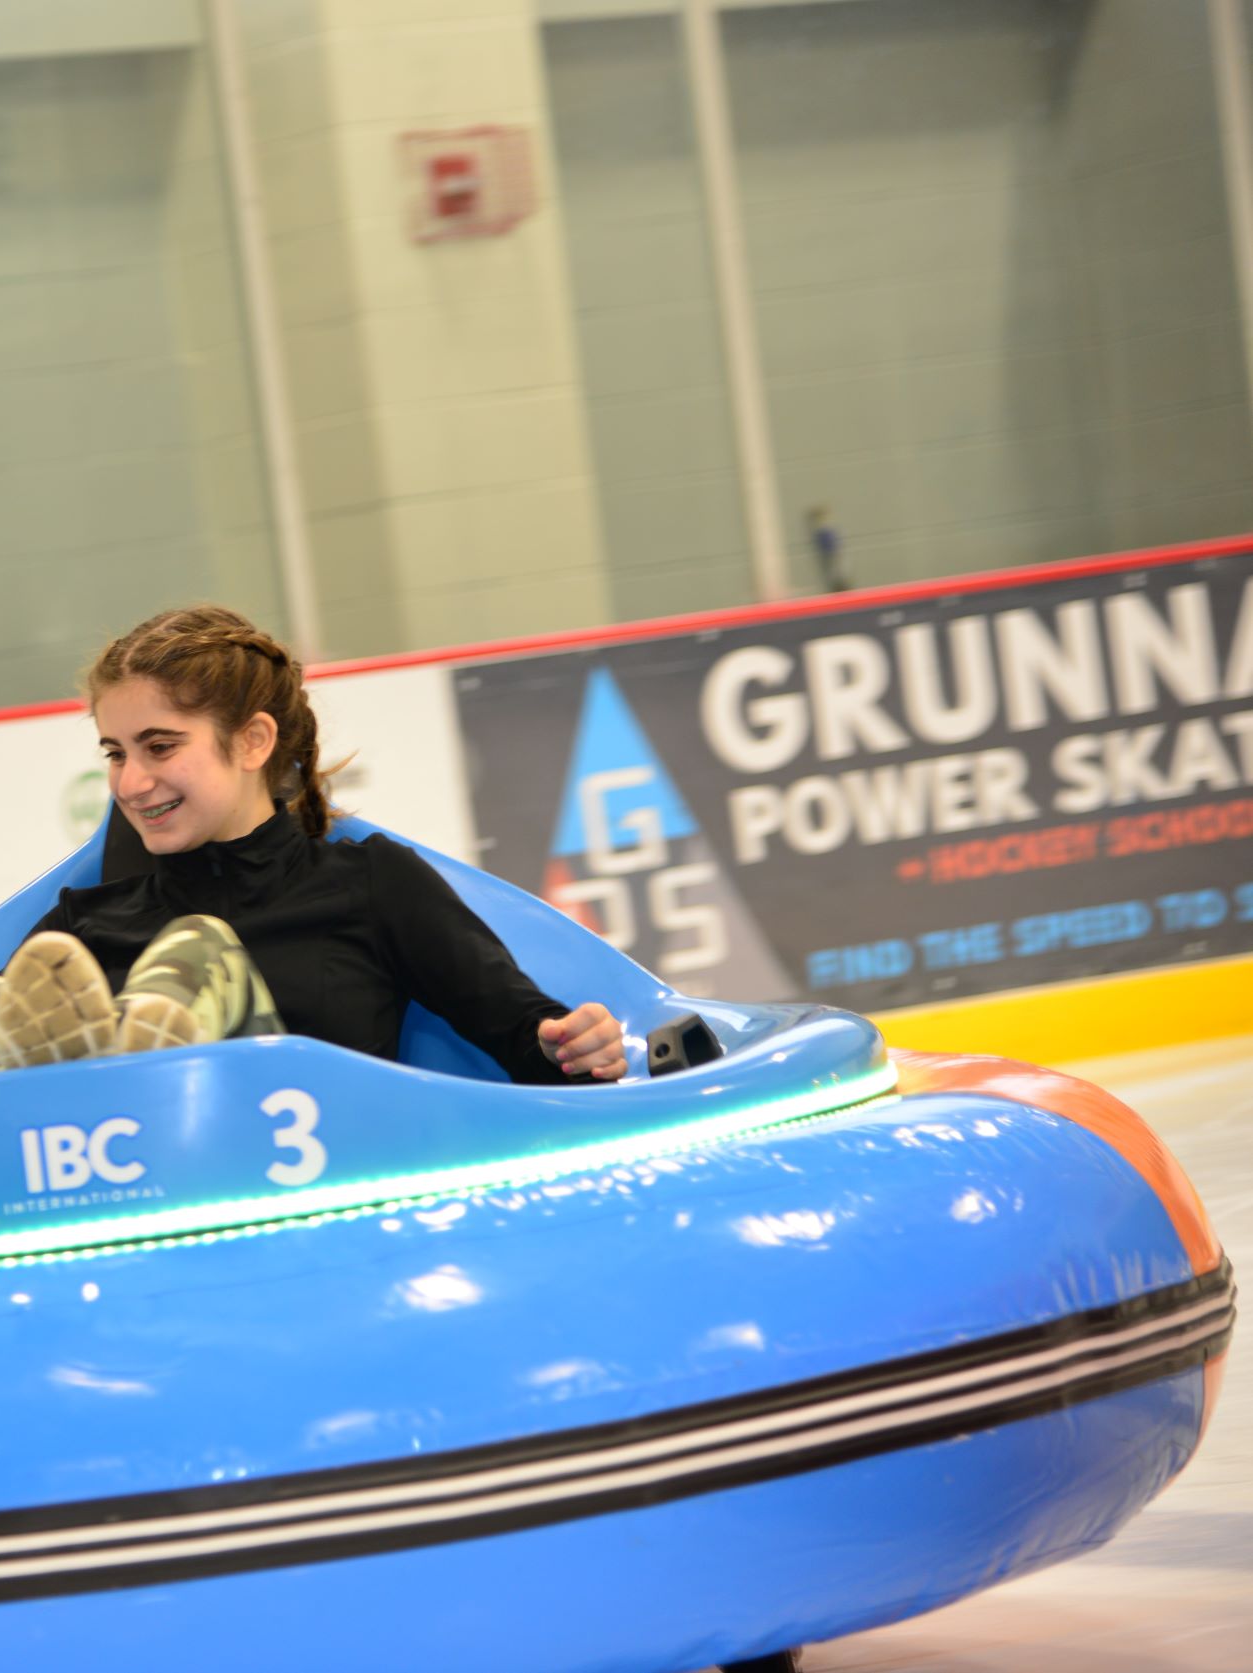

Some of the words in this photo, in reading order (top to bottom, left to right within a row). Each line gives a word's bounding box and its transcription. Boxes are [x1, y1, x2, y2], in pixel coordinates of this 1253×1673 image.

[700, 572, 1253, 774] GRUNN
[728, 747, 1038, 865] POWER
[928, 823, 1100, 884] HOCKEY
[806, 938, 915, 990] FIND
[917, 921, 1006, 971] THE
[1011, 901, 1152, 956] SPEED
[1156, 888, 1229, 933] TO
[20, 1117, 146, 1194] IBC
[260, 1088, 328, 1186] 3
[2, 1184, 167, 1217] INTERNATIONAL
